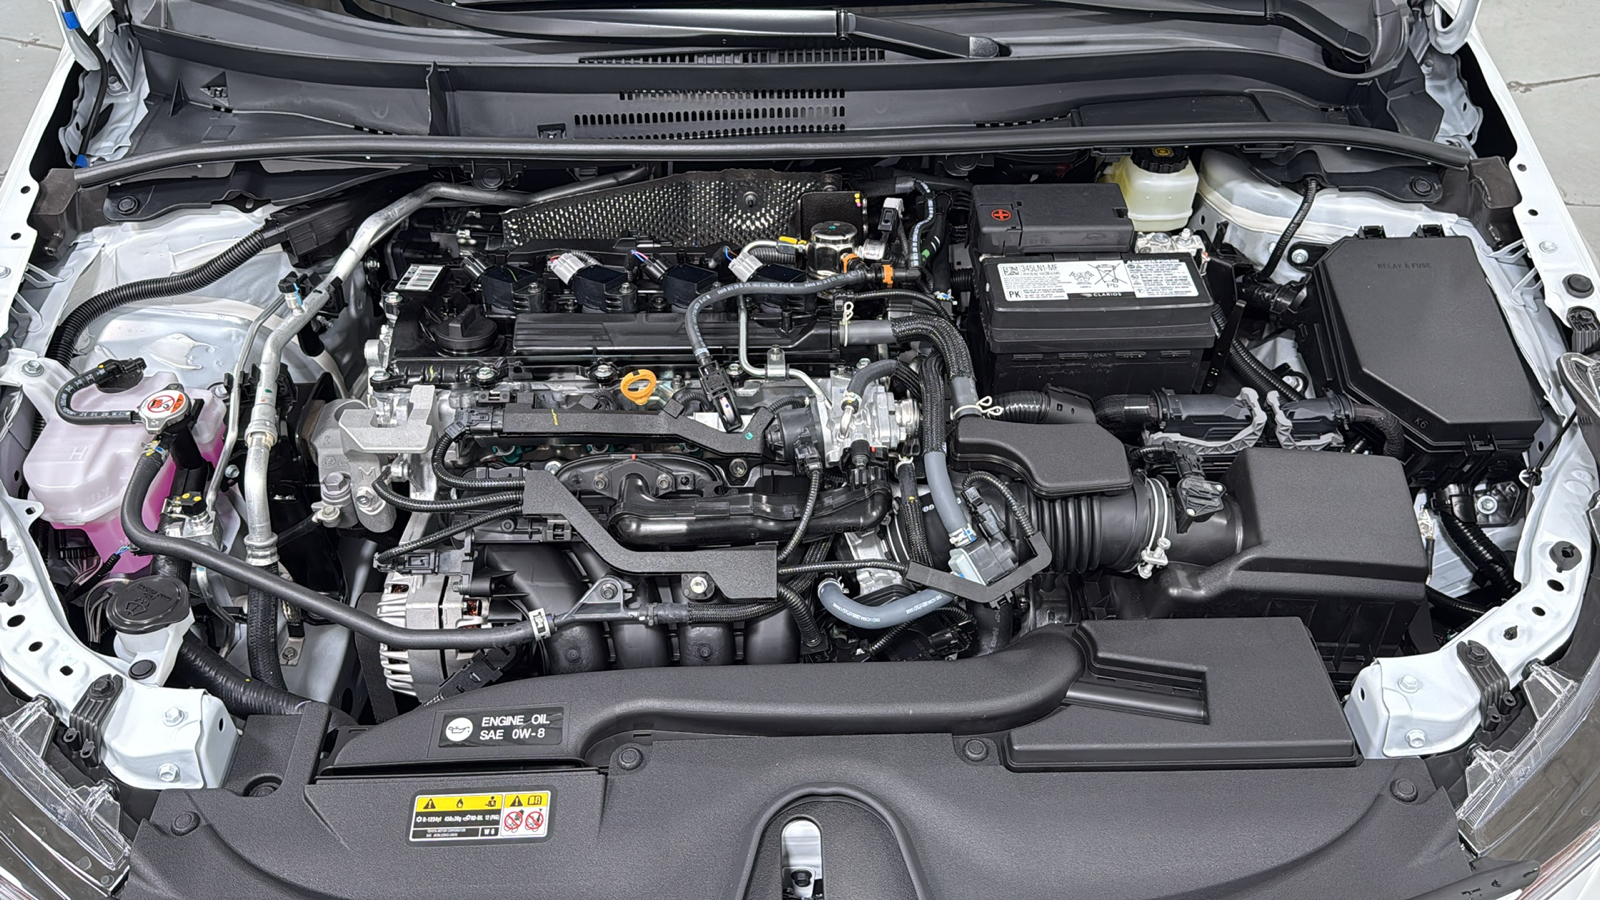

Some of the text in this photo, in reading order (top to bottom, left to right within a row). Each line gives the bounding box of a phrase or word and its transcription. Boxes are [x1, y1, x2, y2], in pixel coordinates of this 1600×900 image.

[1009, 290, 1021, 299] PK
[481, 714, 550, 727] ENGINE OIL
[479, 728, 546, 740] SAE 0W-8
